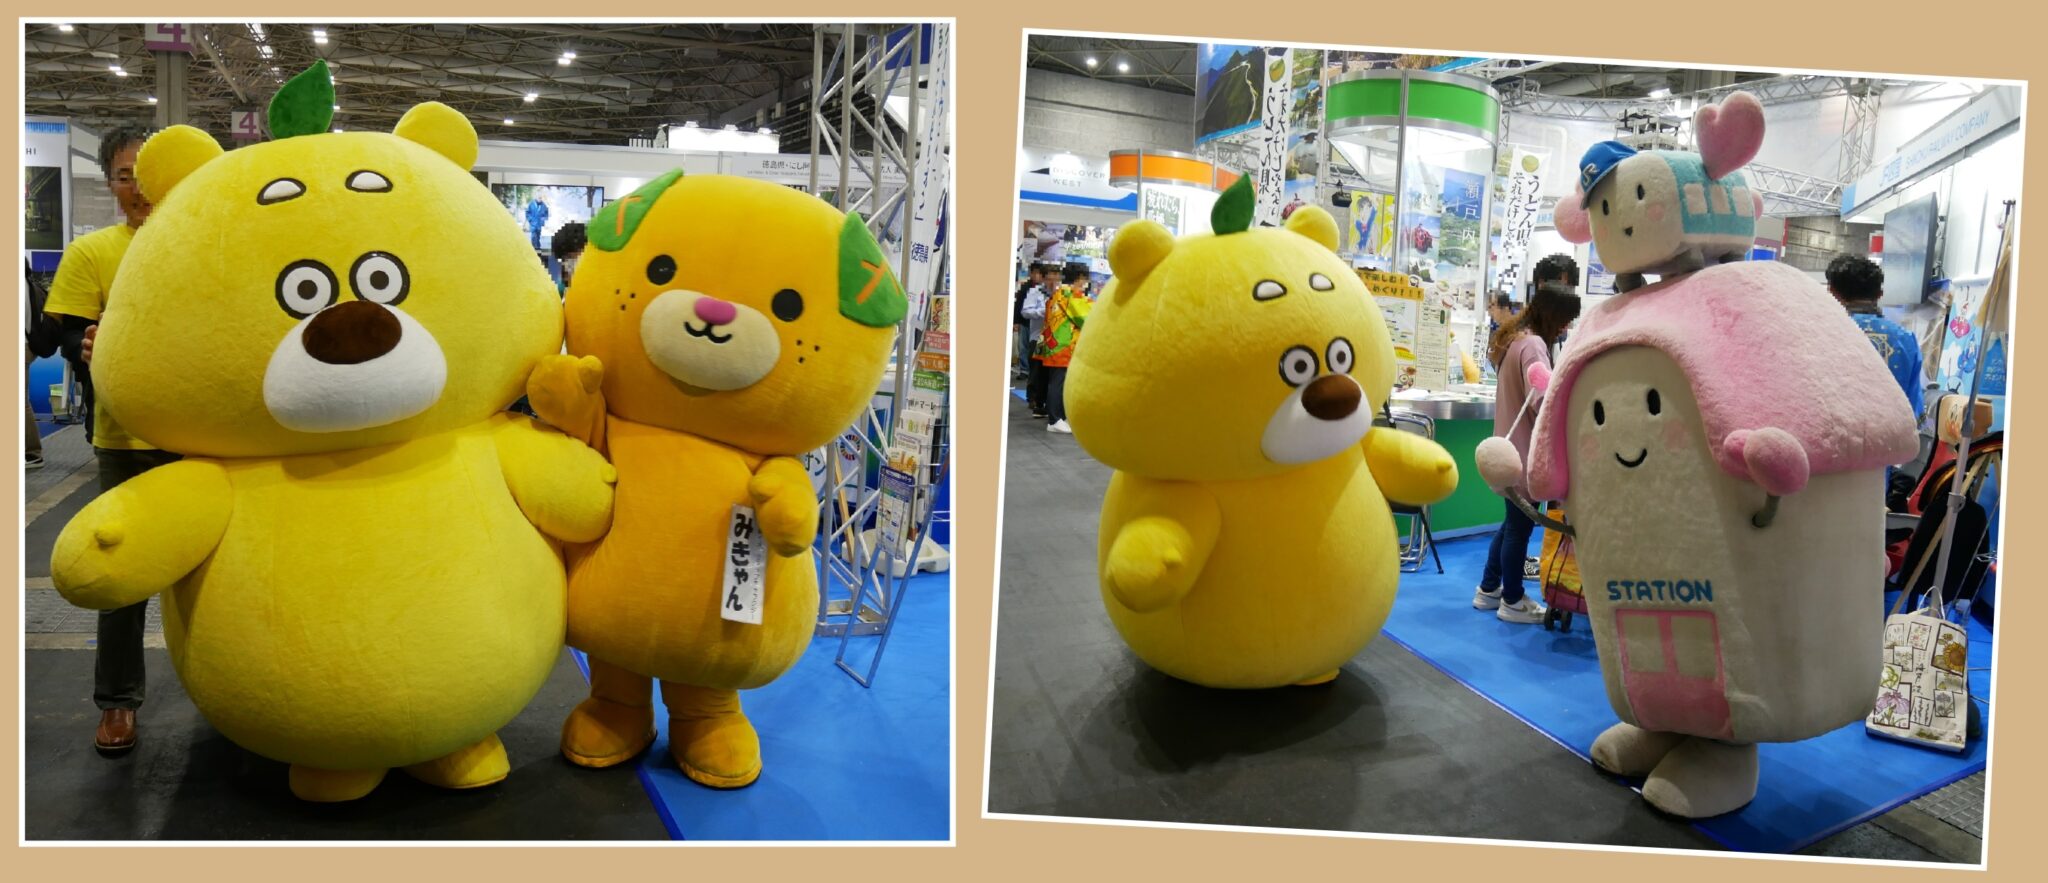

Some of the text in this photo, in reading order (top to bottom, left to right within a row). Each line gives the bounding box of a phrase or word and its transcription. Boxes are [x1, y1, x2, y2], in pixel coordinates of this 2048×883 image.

[239, 112, 257, 134] 4
[1052, 178, 1082, 188] WEST
[725, 513, 754, 612] みきゃん
[1606, 579, 1713, 603] STATION
